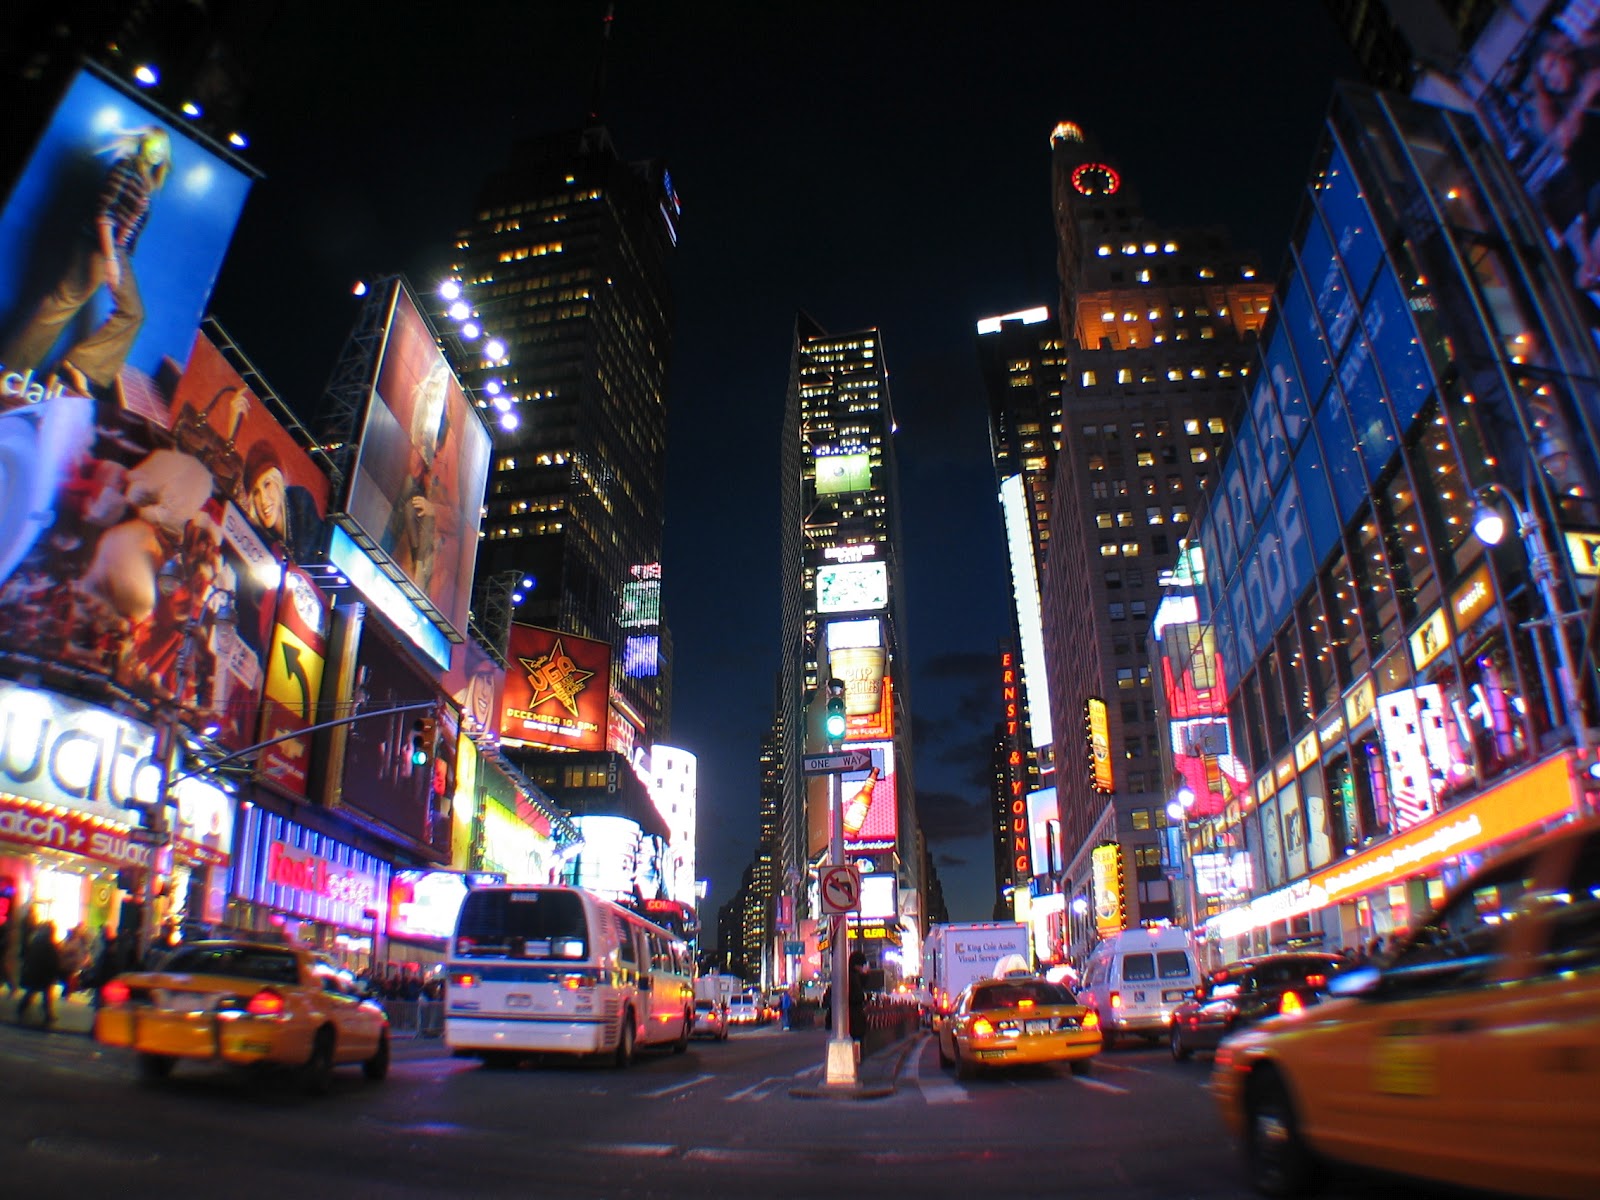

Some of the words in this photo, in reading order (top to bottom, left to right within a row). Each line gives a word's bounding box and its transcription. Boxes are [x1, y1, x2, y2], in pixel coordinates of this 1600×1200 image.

[1002, 654, 1016, 734] ERNST
[507, 708, 560, 725] DECEMBER
[810, 759, 830, 769] ONE
[843, 755, 862, 766] WAY
[1009, 752, 1021, 765] &
[607, 752, 618, 794] 1500
[1011, 781, 1027, 870] YOUNG
[863, 927, 886, 939] CLEAR
[967, 943, 982, 953] King
[983, 942, 997, 951] Cole
[998, 942, 1017, 951] Audio
[958, 955, 977, 963] Visual
